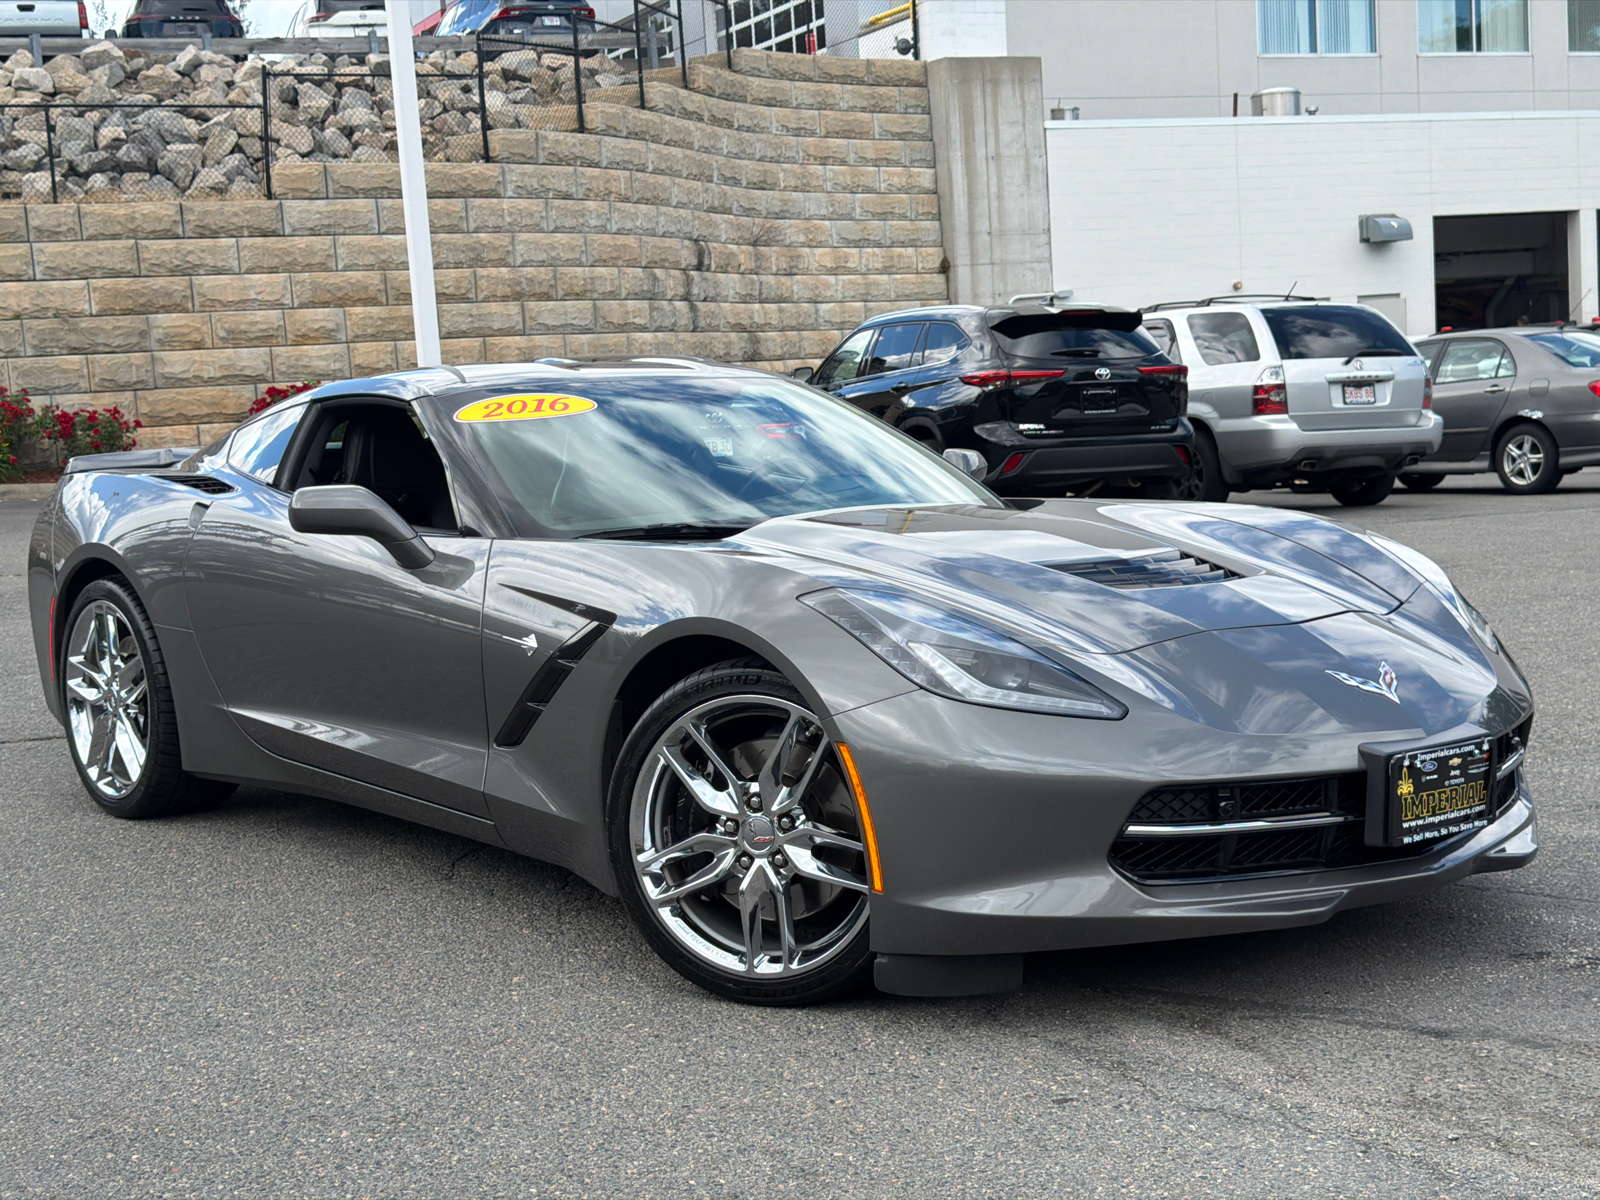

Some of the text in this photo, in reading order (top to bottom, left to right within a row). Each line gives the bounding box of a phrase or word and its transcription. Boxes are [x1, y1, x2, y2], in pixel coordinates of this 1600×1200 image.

[482, 396, 570, 419] 2016
[685, 674, 758, 693] MICHELIN
[1417, 744, 1476, 762] Imperialcars.com
[1402, 780, 1487, 820] IMPERIAL
[1402, 804, 1486, 828] www.imperialcars.com
[1403, 820, 1487, 844] We Sell More, So You Save More
